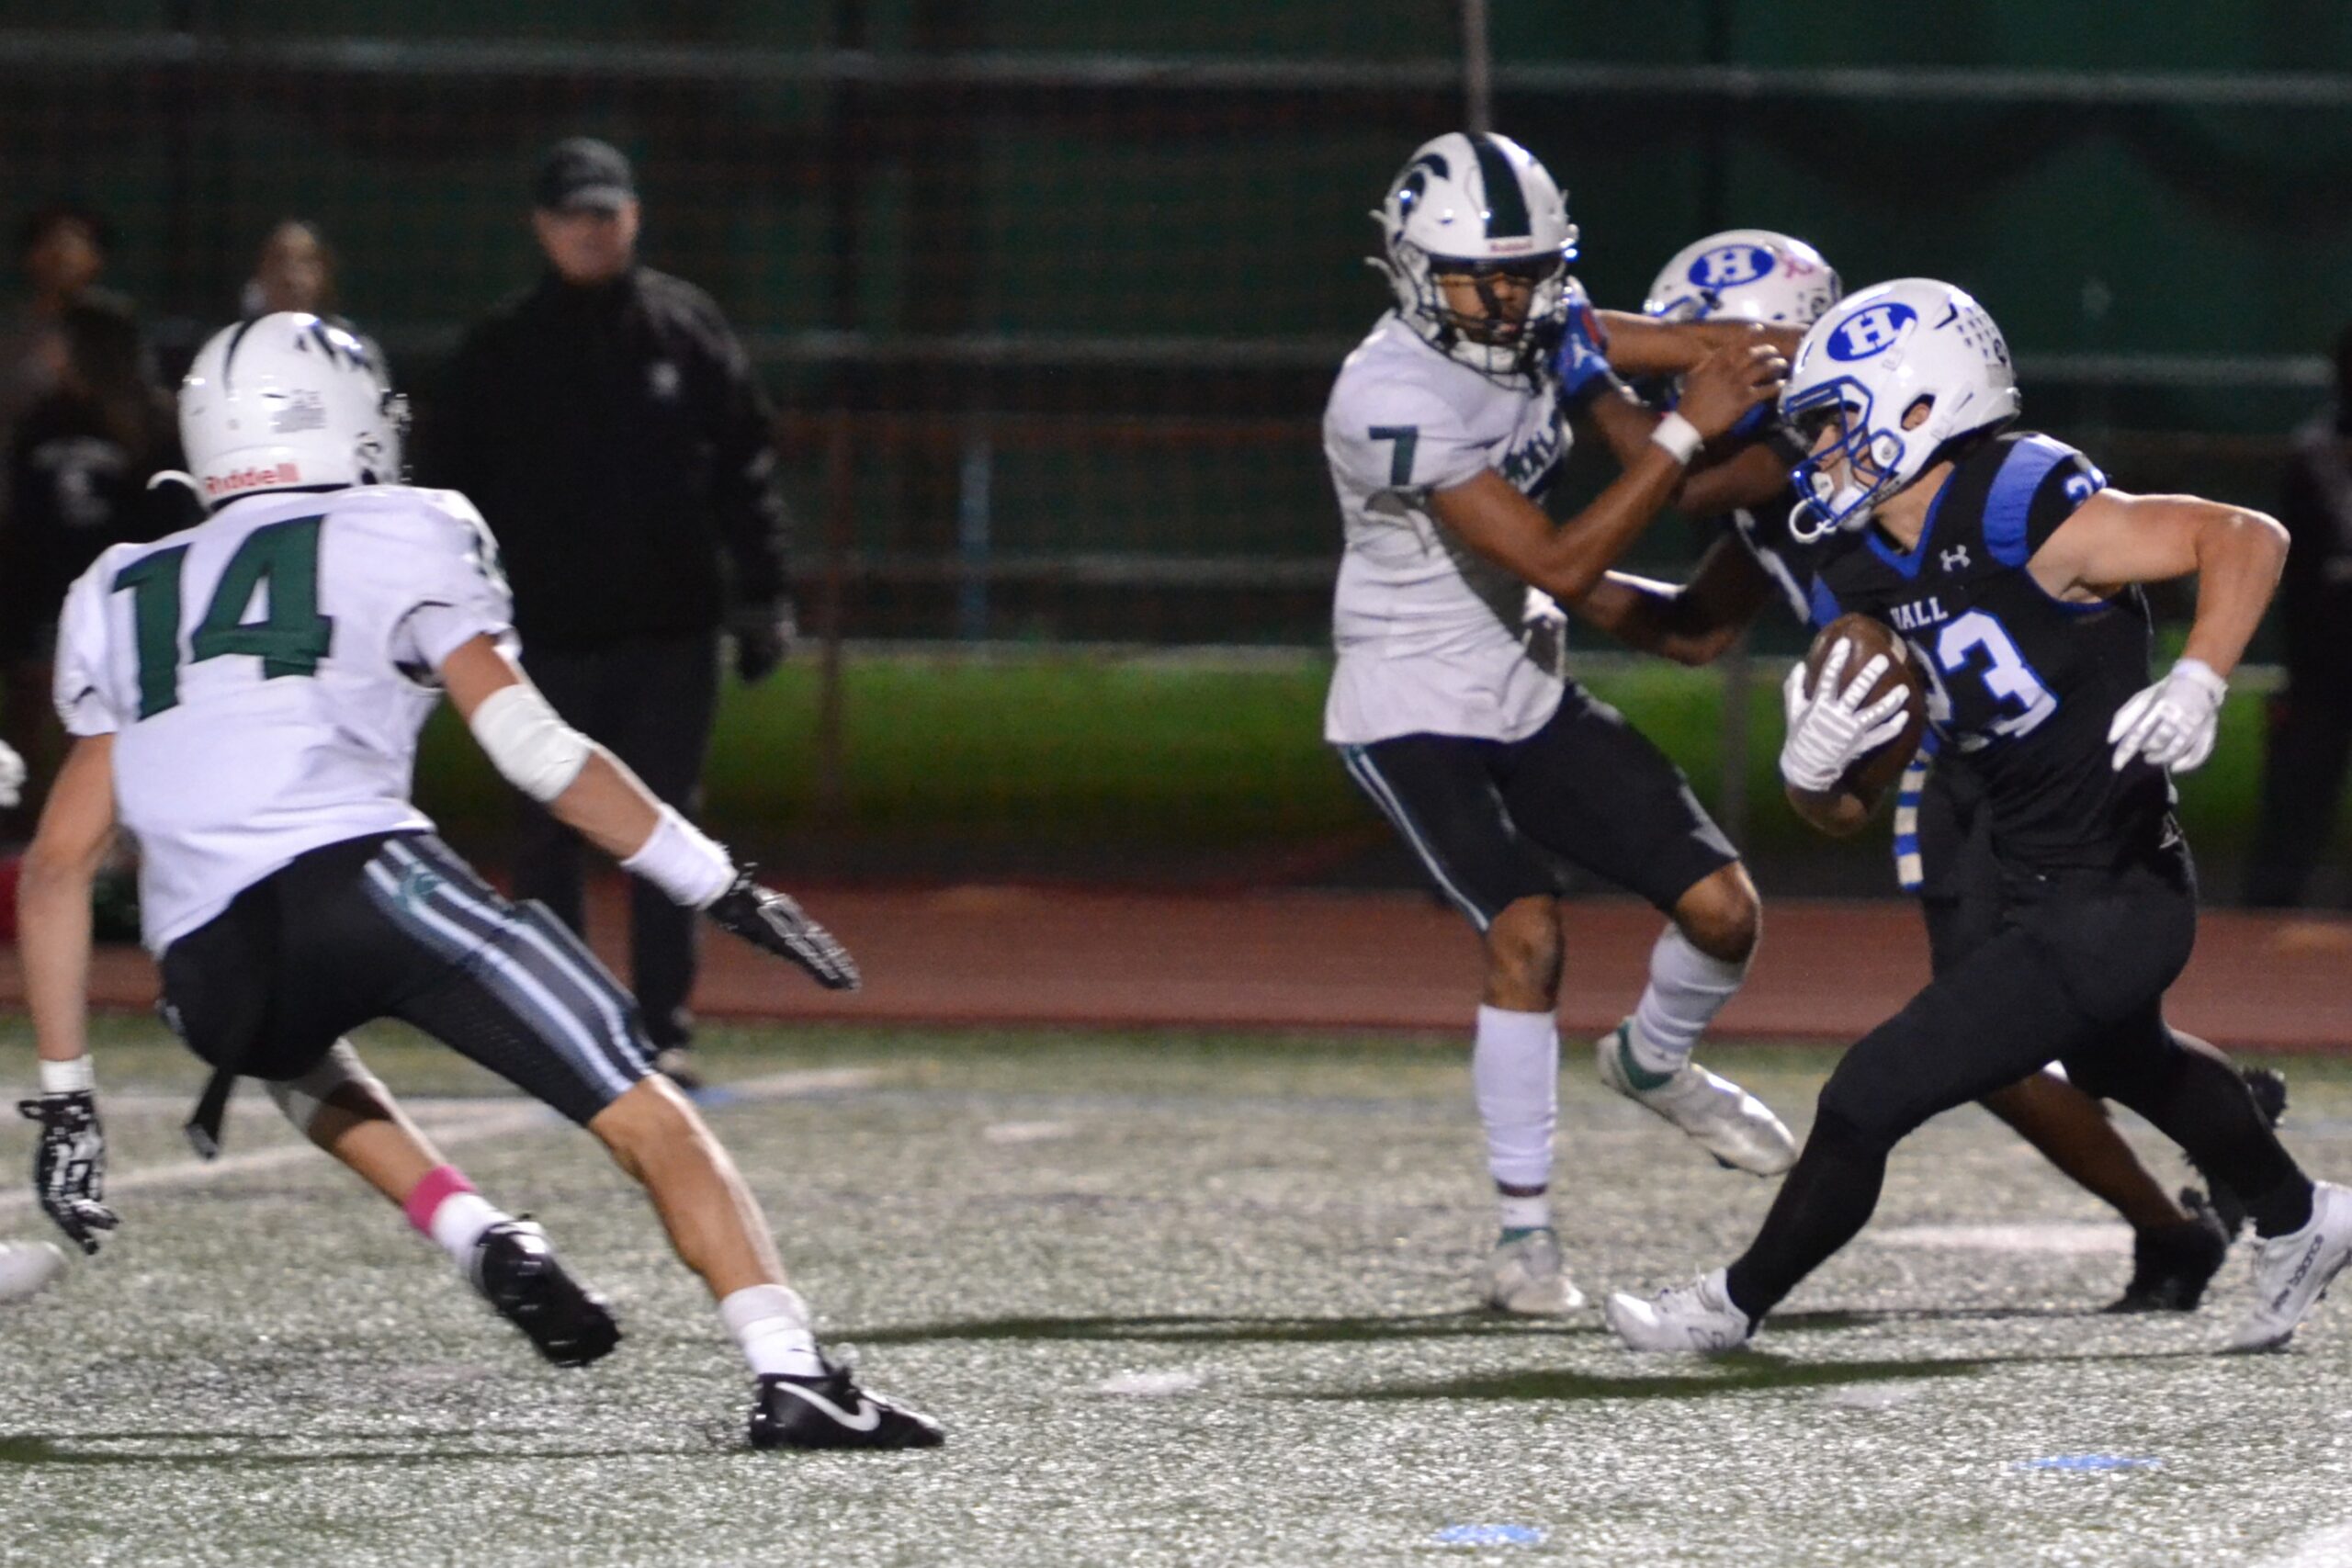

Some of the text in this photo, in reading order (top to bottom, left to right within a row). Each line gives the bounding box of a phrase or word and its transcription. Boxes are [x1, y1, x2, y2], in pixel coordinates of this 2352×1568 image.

[1704, 249, 1758, 284] H
[1839, 306, 1898, 356] H
[1367, 425, 1419, 486] 7
[109, 513, 334, 723] 14
